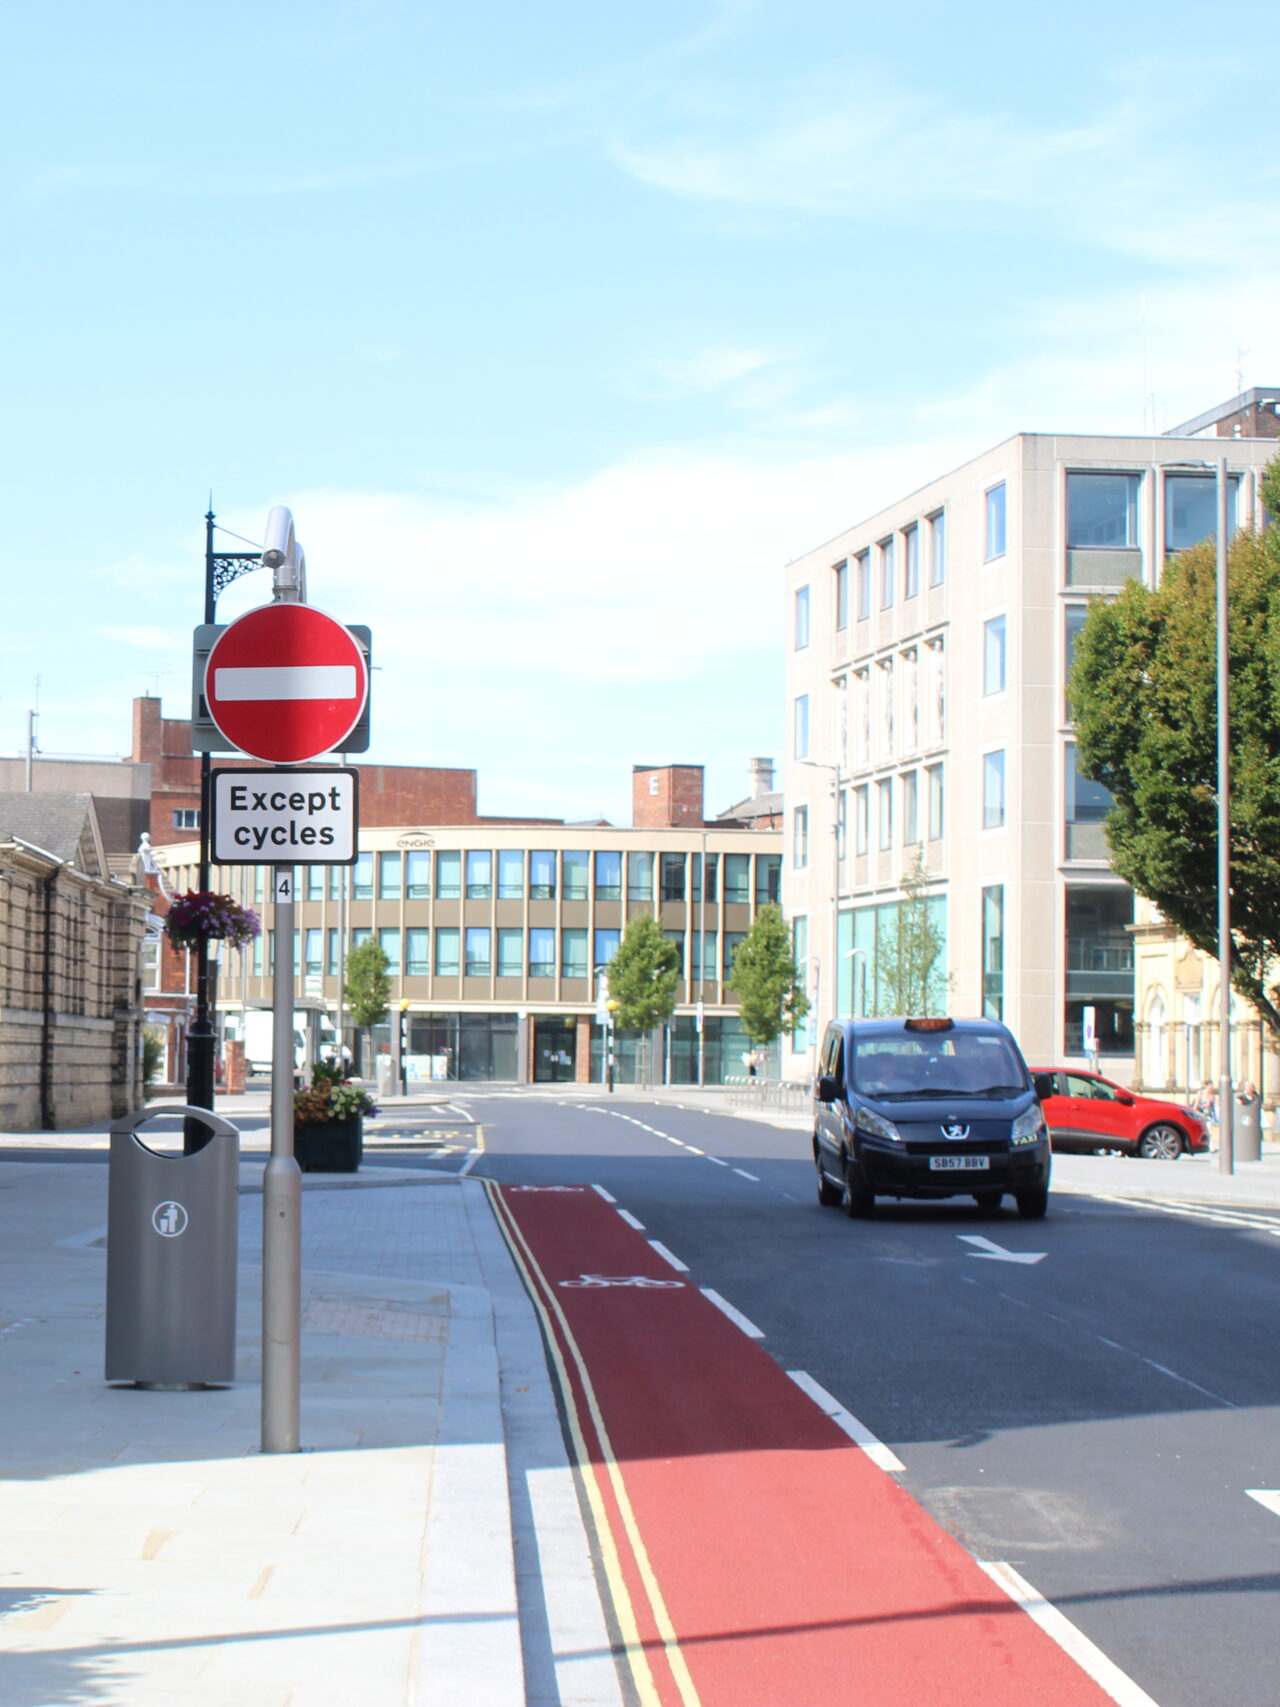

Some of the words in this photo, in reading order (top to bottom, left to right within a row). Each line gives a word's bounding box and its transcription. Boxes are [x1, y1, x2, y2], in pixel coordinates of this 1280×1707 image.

[230, 786, 341, 815] Except
[234, 820, 335, 850] cycles
[278, 879, 290, 896] 4
[1013, 1133, 1038, 1145] TAXI
[934, 1157, 961, 1168] SB57
